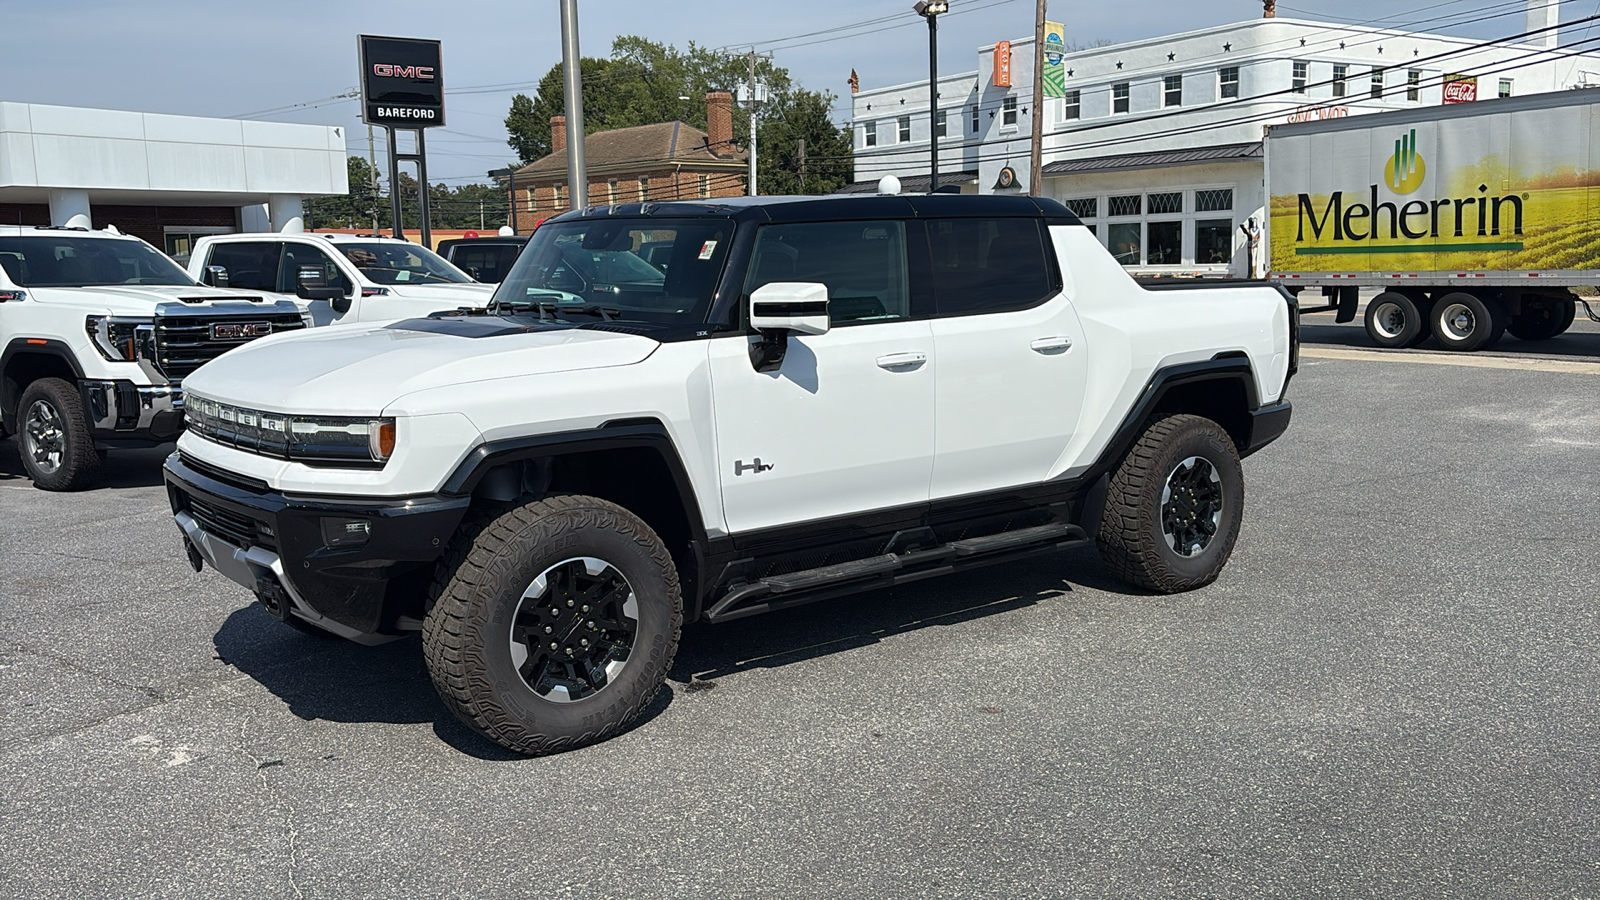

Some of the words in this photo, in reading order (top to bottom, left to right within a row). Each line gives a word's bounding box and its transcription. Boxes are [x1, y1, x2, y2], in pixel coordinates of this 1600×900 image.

[374, 64, 434, 79] GMC
[377, 107, 435, 119] BAREFORD
[215, 324, 270, 337] GMC
[492, 532, 579, 624] WRANGLER
